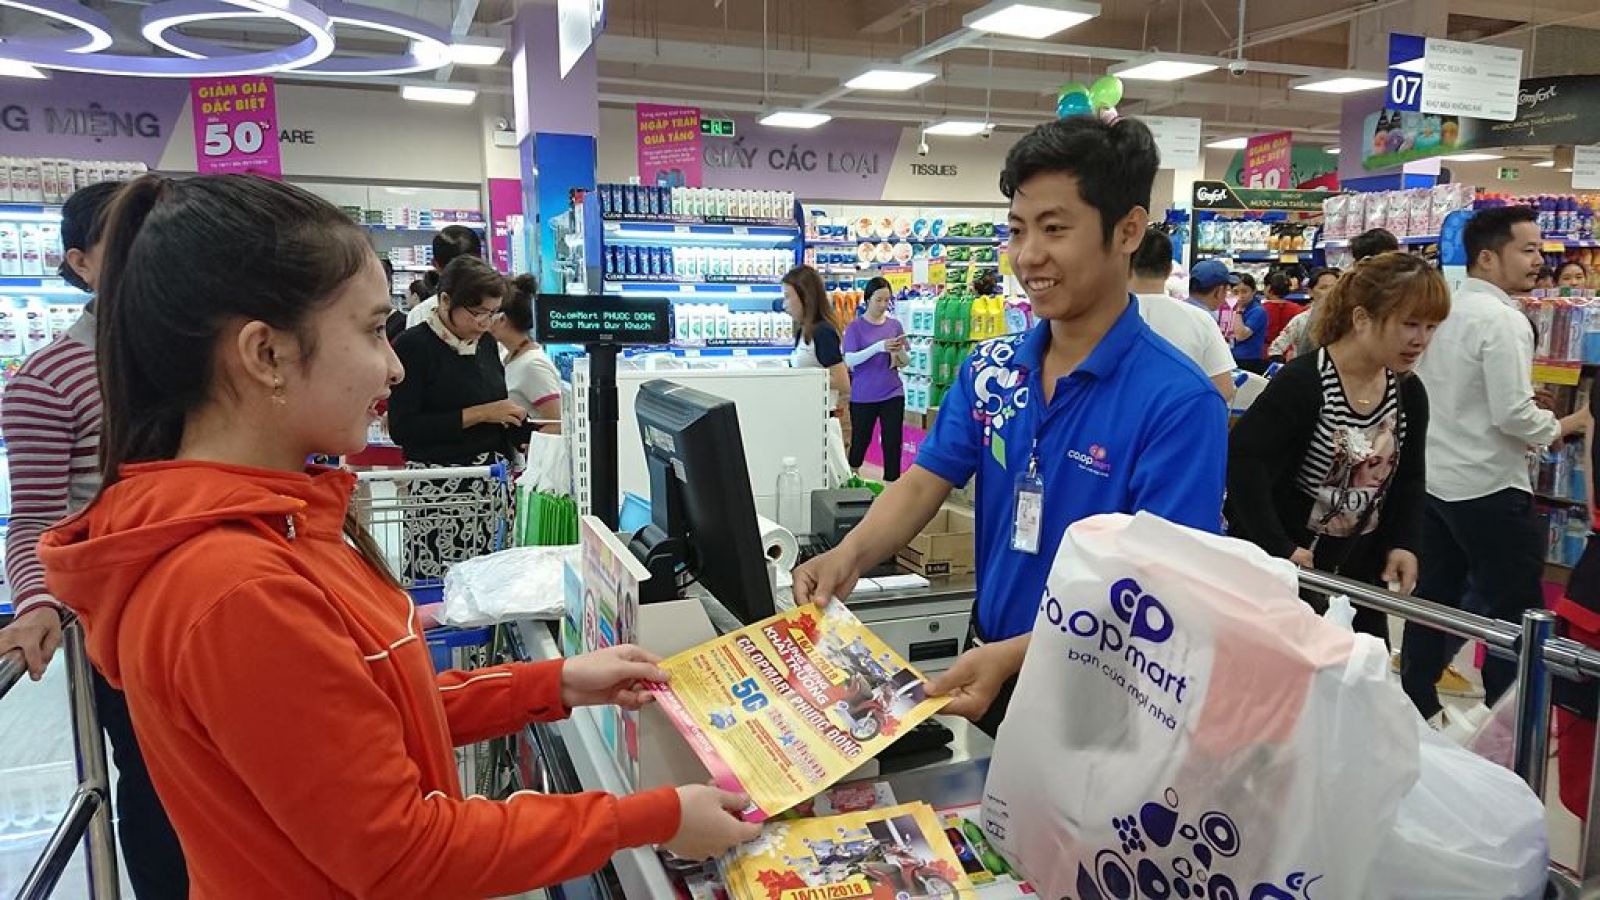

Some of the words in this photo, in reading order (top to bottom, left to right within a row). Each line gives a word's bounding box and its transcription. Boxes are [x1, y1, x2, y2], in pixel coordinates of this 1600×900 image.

[198, 81, 237, 98] GIẢM
[235, 95, 265, 112] BIỆT
[1391, 74, 1421, 105] 07
[44, 102, 160, 143] MIỆNG
[703, 136, 757, 168] GIẤY
[768, 144, 817, 171] CÁC
[827, 152, 879, 178] LOẠI
[910, 163, 957, 176] TISSUES
[624, 320, 651, 331] Khach
[764, 626, 788, 656] KHAI
[1068, 649, 1100, 667] bạn
[1102, 663, 1126, 687] của
[1148, 703, 1178, 731] nhà
